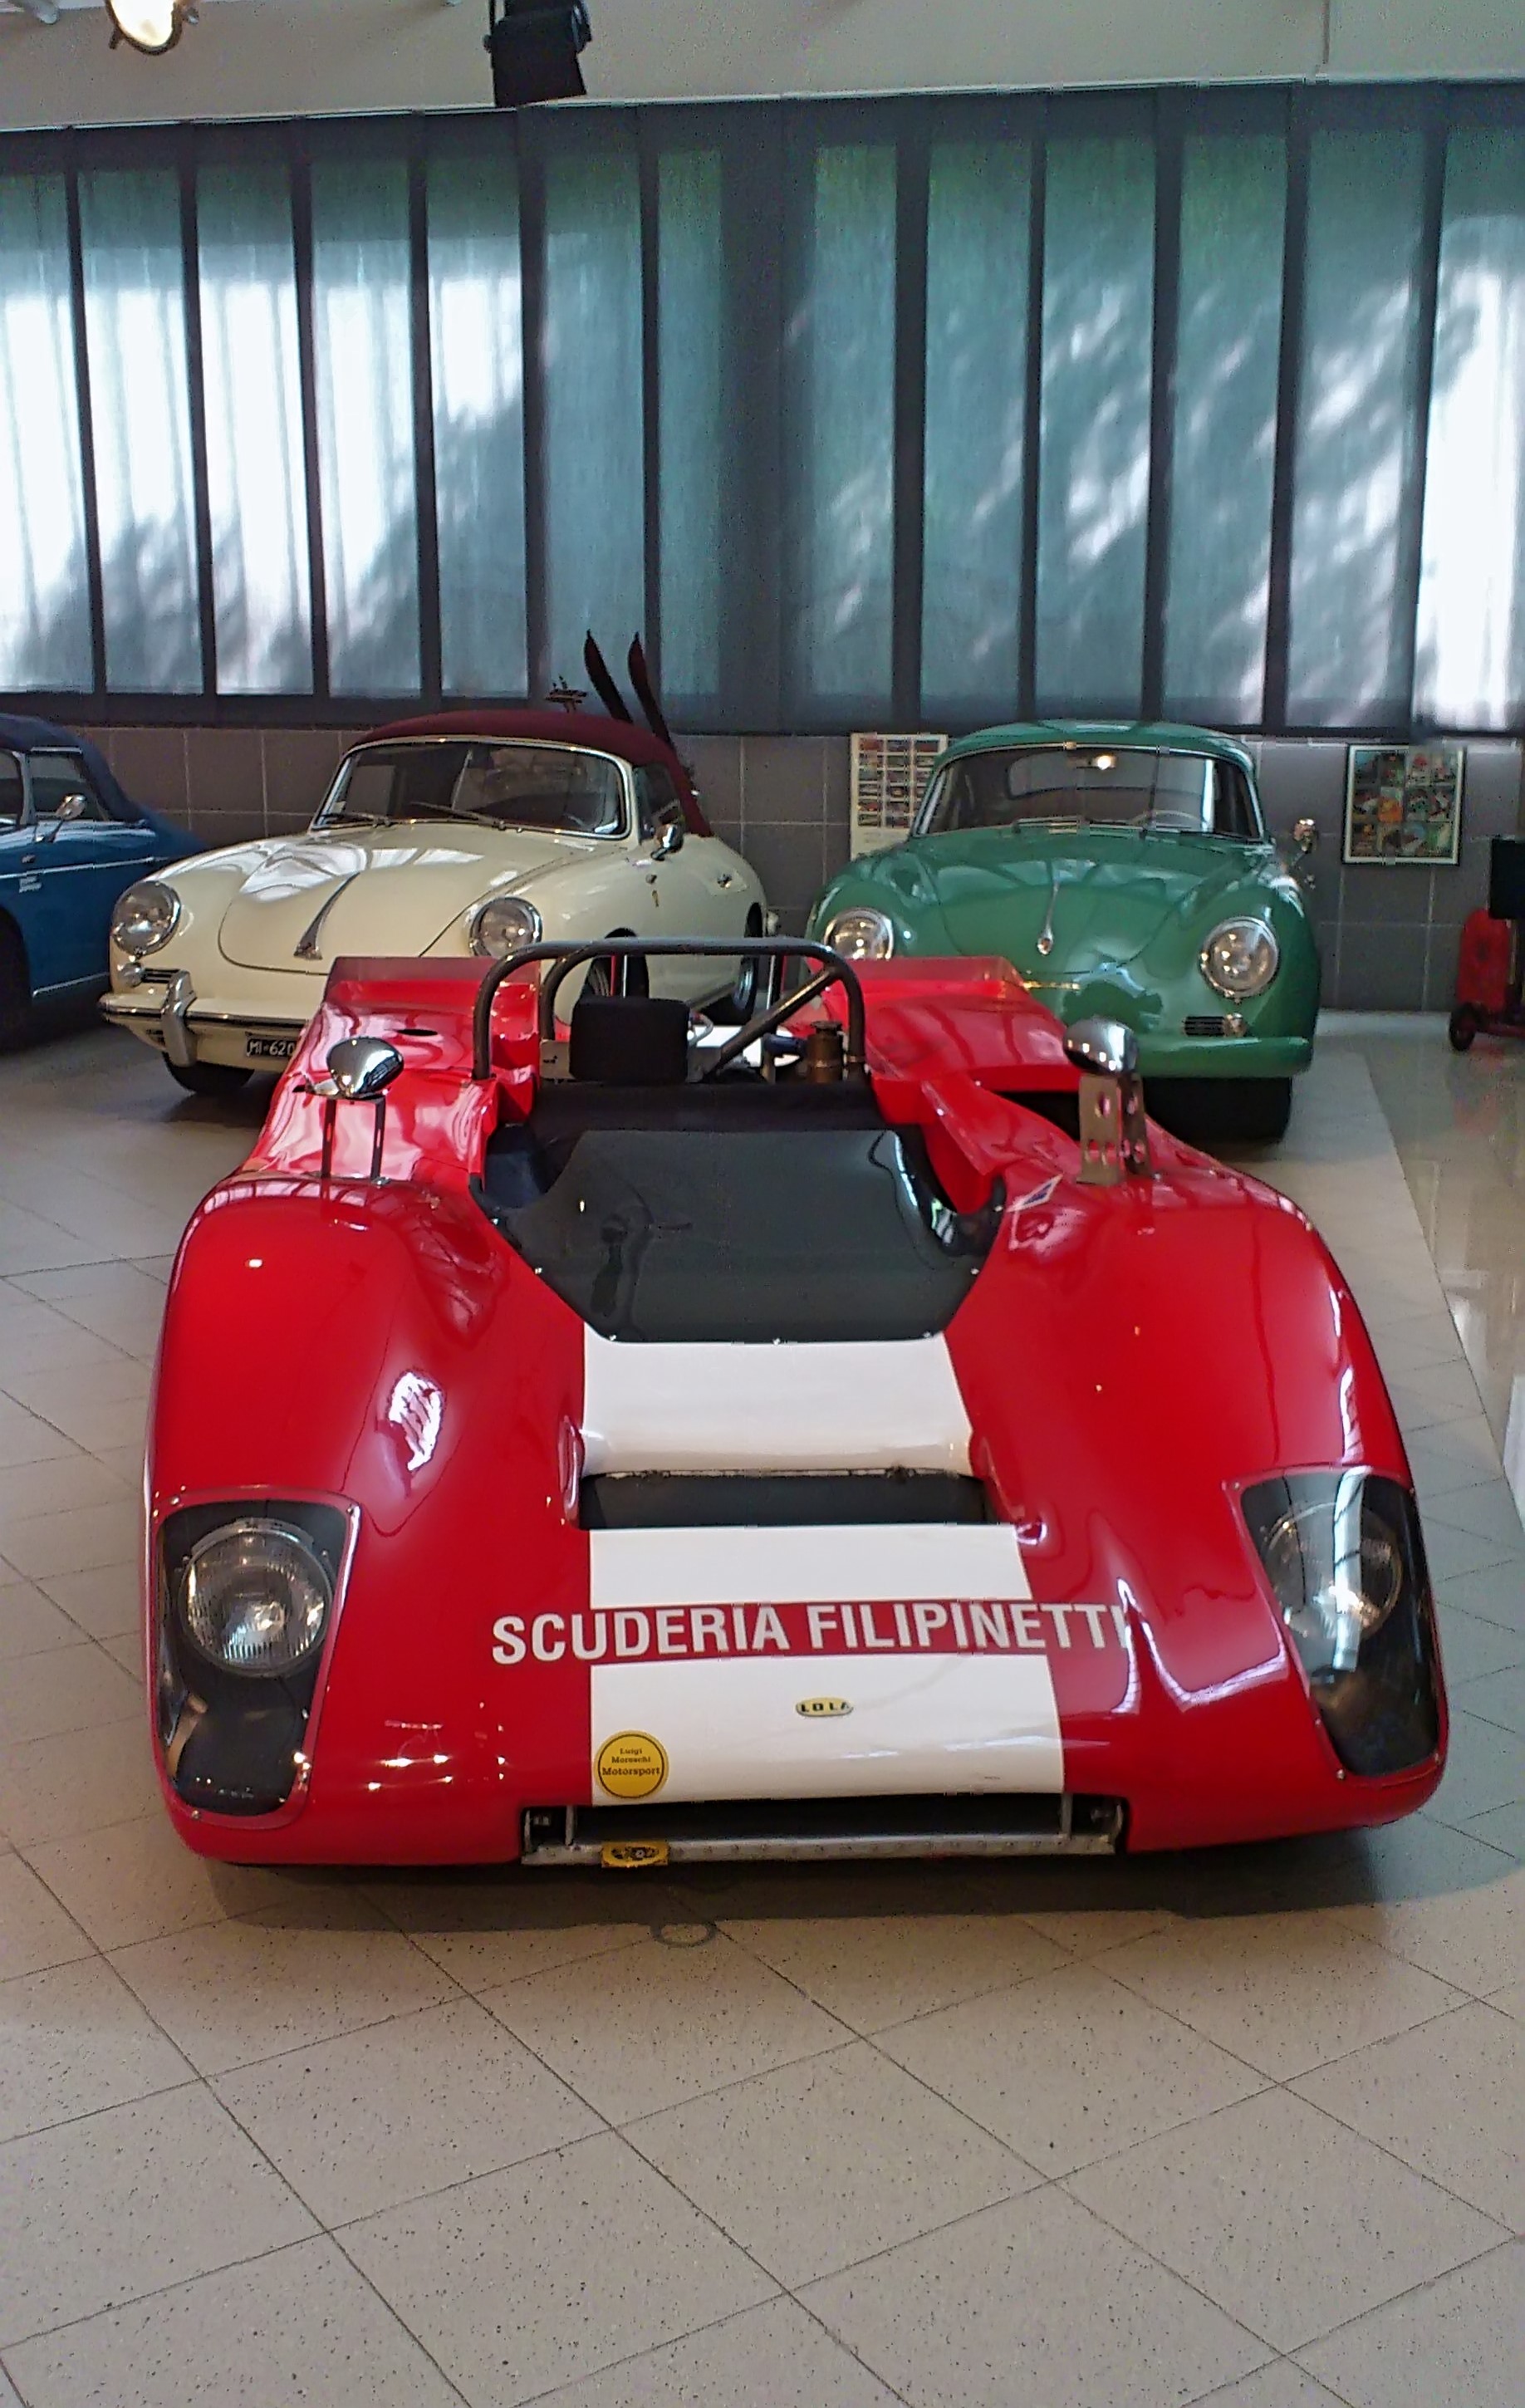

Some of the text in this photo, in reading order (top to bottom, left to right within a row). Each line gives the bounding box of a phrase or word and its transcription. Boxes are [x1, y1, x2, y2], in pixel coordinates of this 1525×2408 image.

[492, 1602, 1128, 1665] SCUDERIA FILIPINETTI
[801, 1701, 850, 1713] LOLA
[602, 1767, 660, 1776] Motorsport
